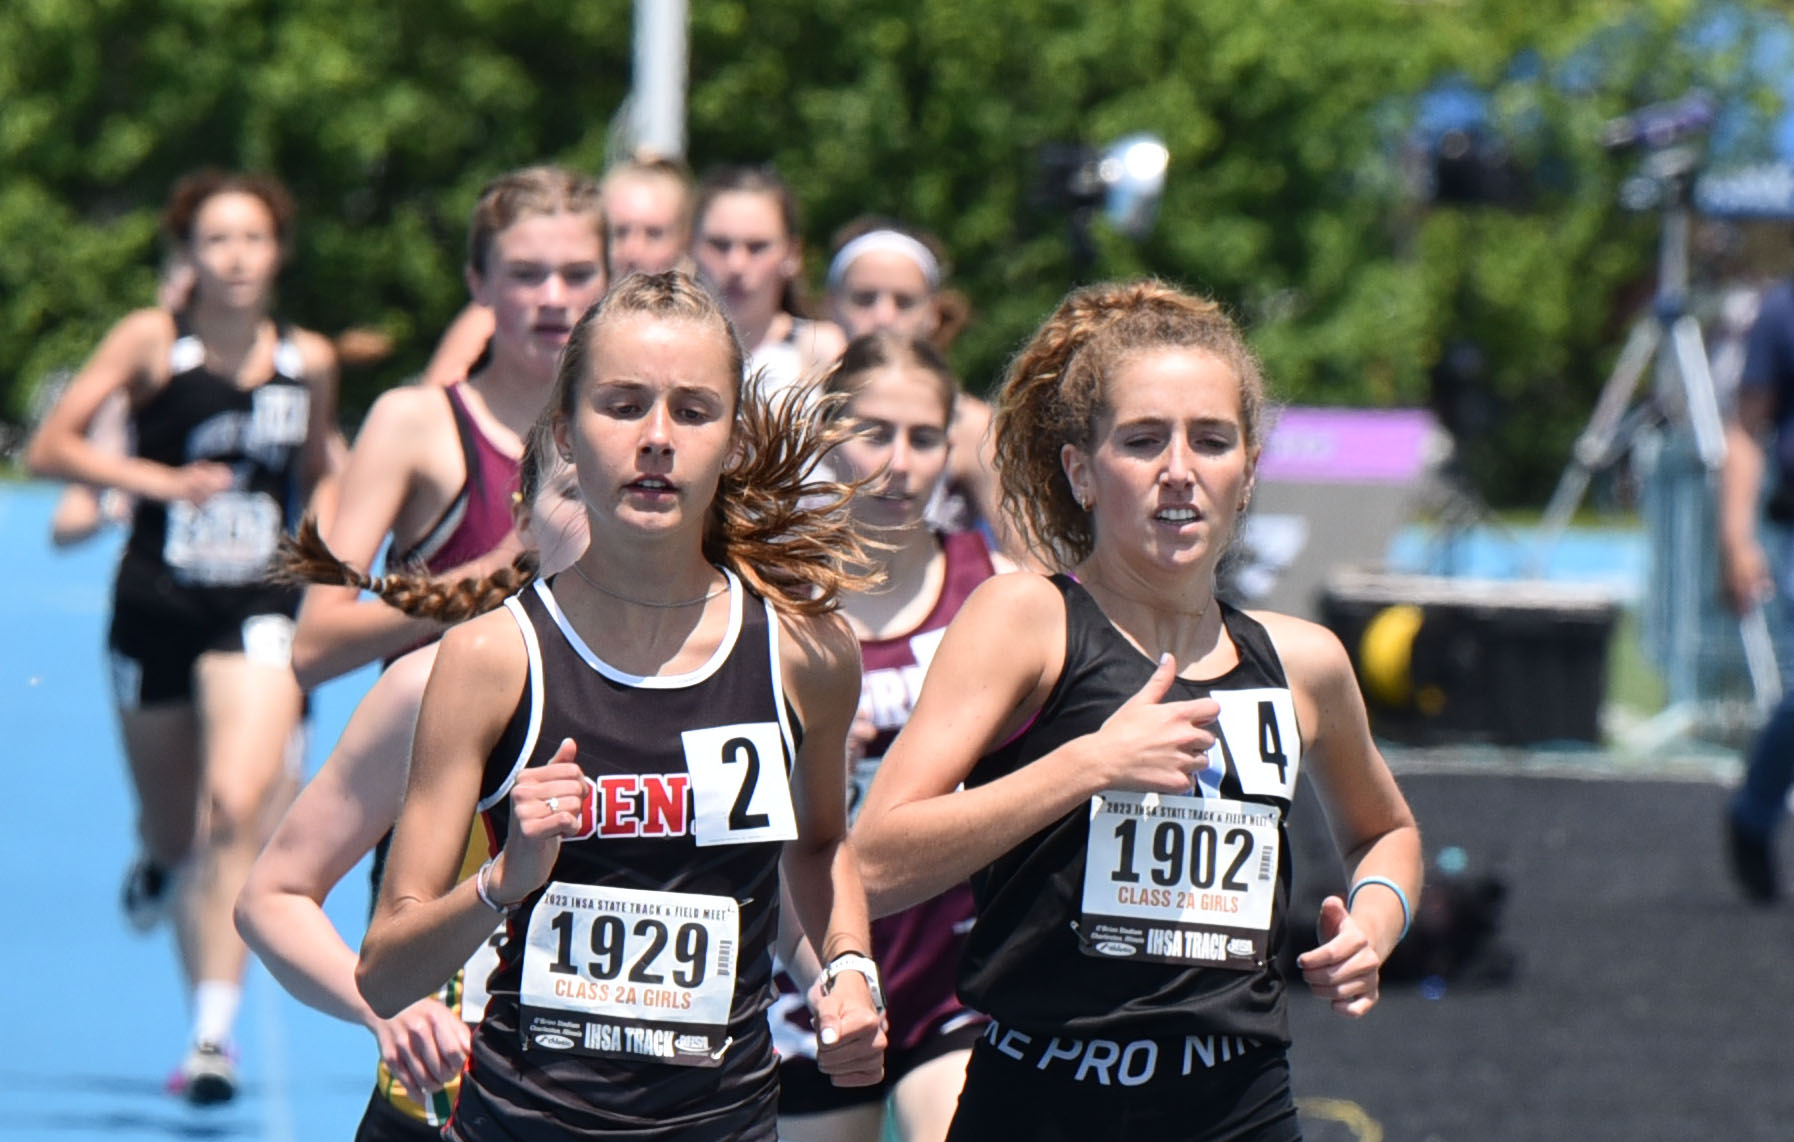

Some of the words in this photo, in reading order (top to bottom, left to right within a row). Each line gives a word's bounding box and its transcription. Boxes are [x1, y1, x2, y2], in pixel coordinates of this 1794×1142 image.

[1258, 701, 1288, 785] 4
[722, 736, 770, 831] 2
[1160, 806, 1186, 818] STATE
[1189, 809, 1214, 822] TRACK
[1111, 818, 1254, 892] 1902
[598, 899, 626, 912] STATE
[630, 902, 661, 916] TRACK
[703, 908, 726, 921] MEET
[1118, 886, 1171, 907] CLASS
[1176, 892, 1195, 910] 2A
[1200, 893, 1238, 913] GIRLS
[549, 911, 708, 989] 1929
[1184, 931, 1228, 961] TRACK
[555, 979, 609, 1001] CLASS
[615, 985, 636, 1005] 2A
[643, 988, 692, 1010] GIRLS
[585, 1022, 621, 1052] IHSA
[624, 1026, 675, 1057] TRACK
[1036, 1038, 1158, 1087] PRO
